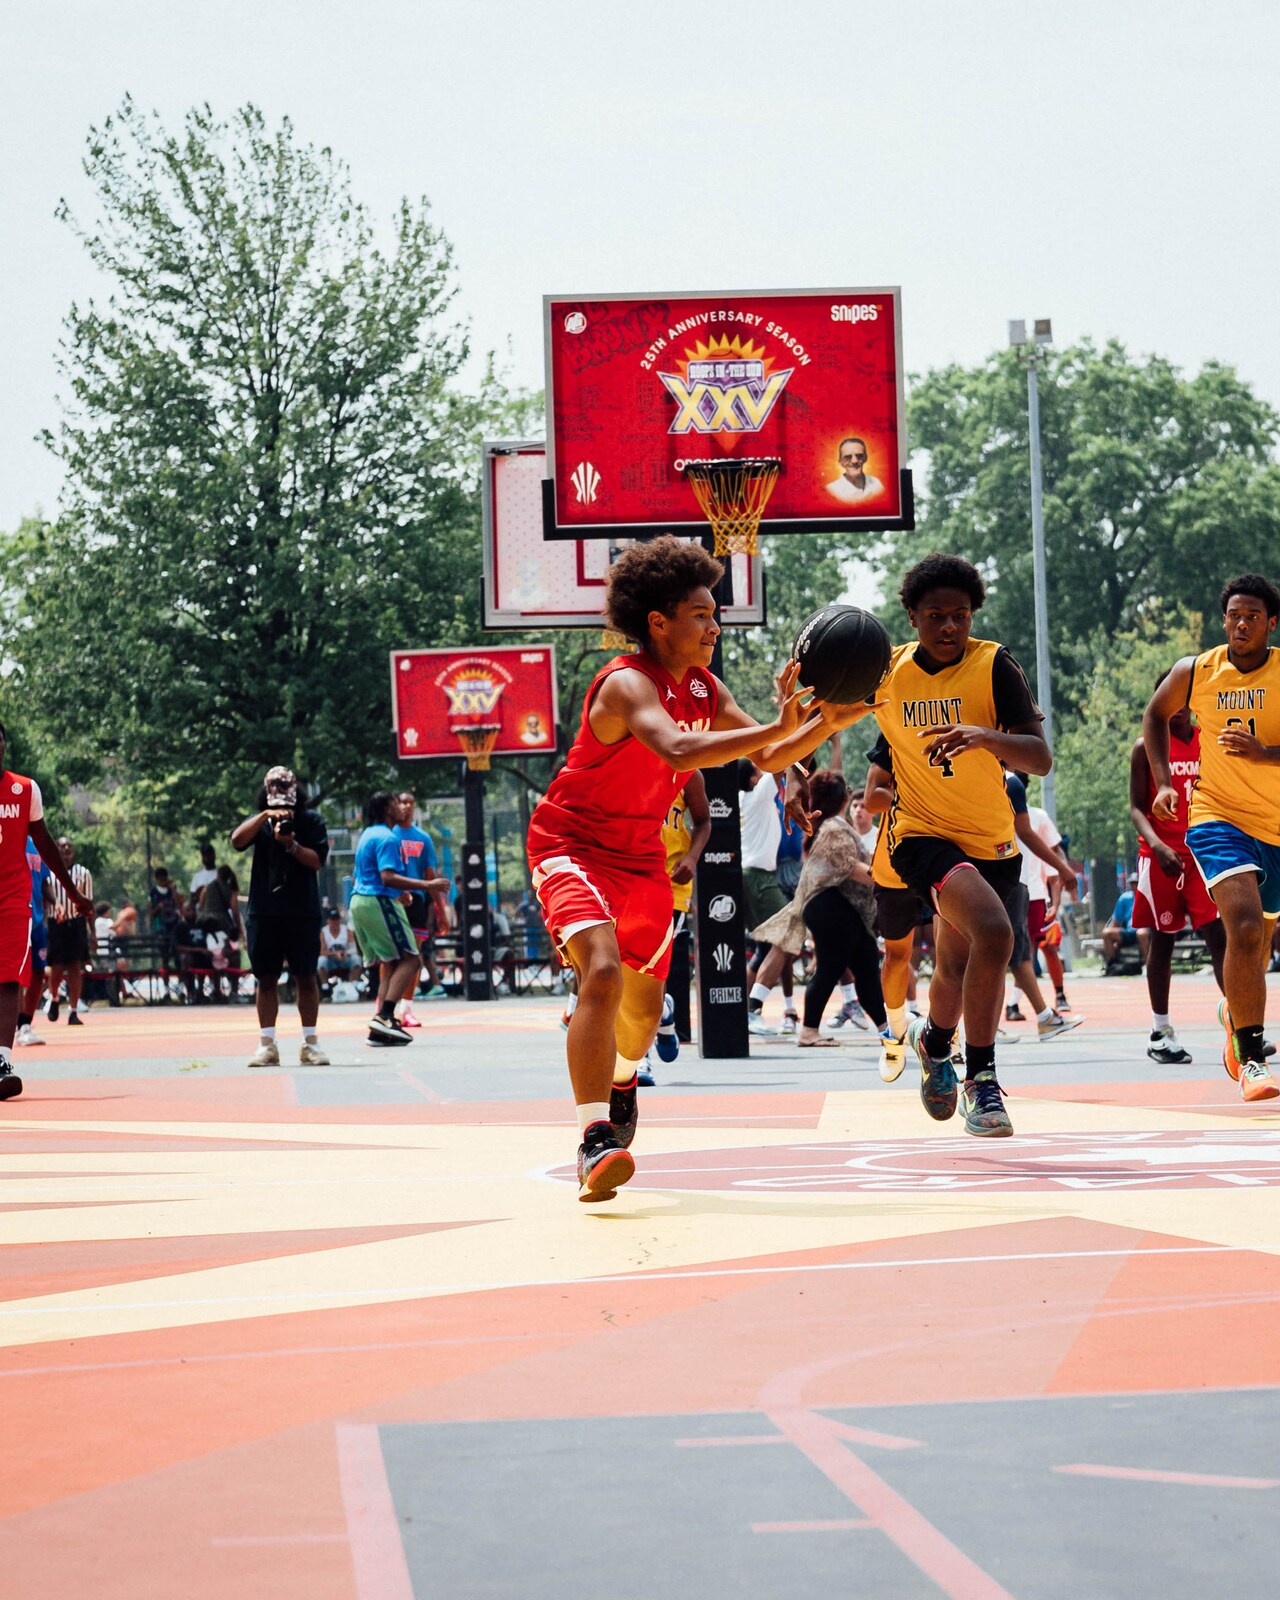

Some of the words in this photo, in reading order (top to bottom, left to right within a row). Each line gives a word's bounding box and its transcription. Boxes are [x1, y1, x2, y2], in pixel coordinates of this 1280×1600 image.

[830, 304, 878, 324] snipes
[640, 337, 667, 370] 25TH
[668, 310, 763, 340] ANNIVERSARY
[766, 321, 811, 366] SEASON
[657, 368, 795, 434] XXV
[442, 684, 506, 715] XXV
[1216, 688, 1265, 710] MOUNT
[902, 697, 962, 729] MOUNT
[705, 852, 732, 864] snipes
[709, 986, 742, 1004] PRIME
